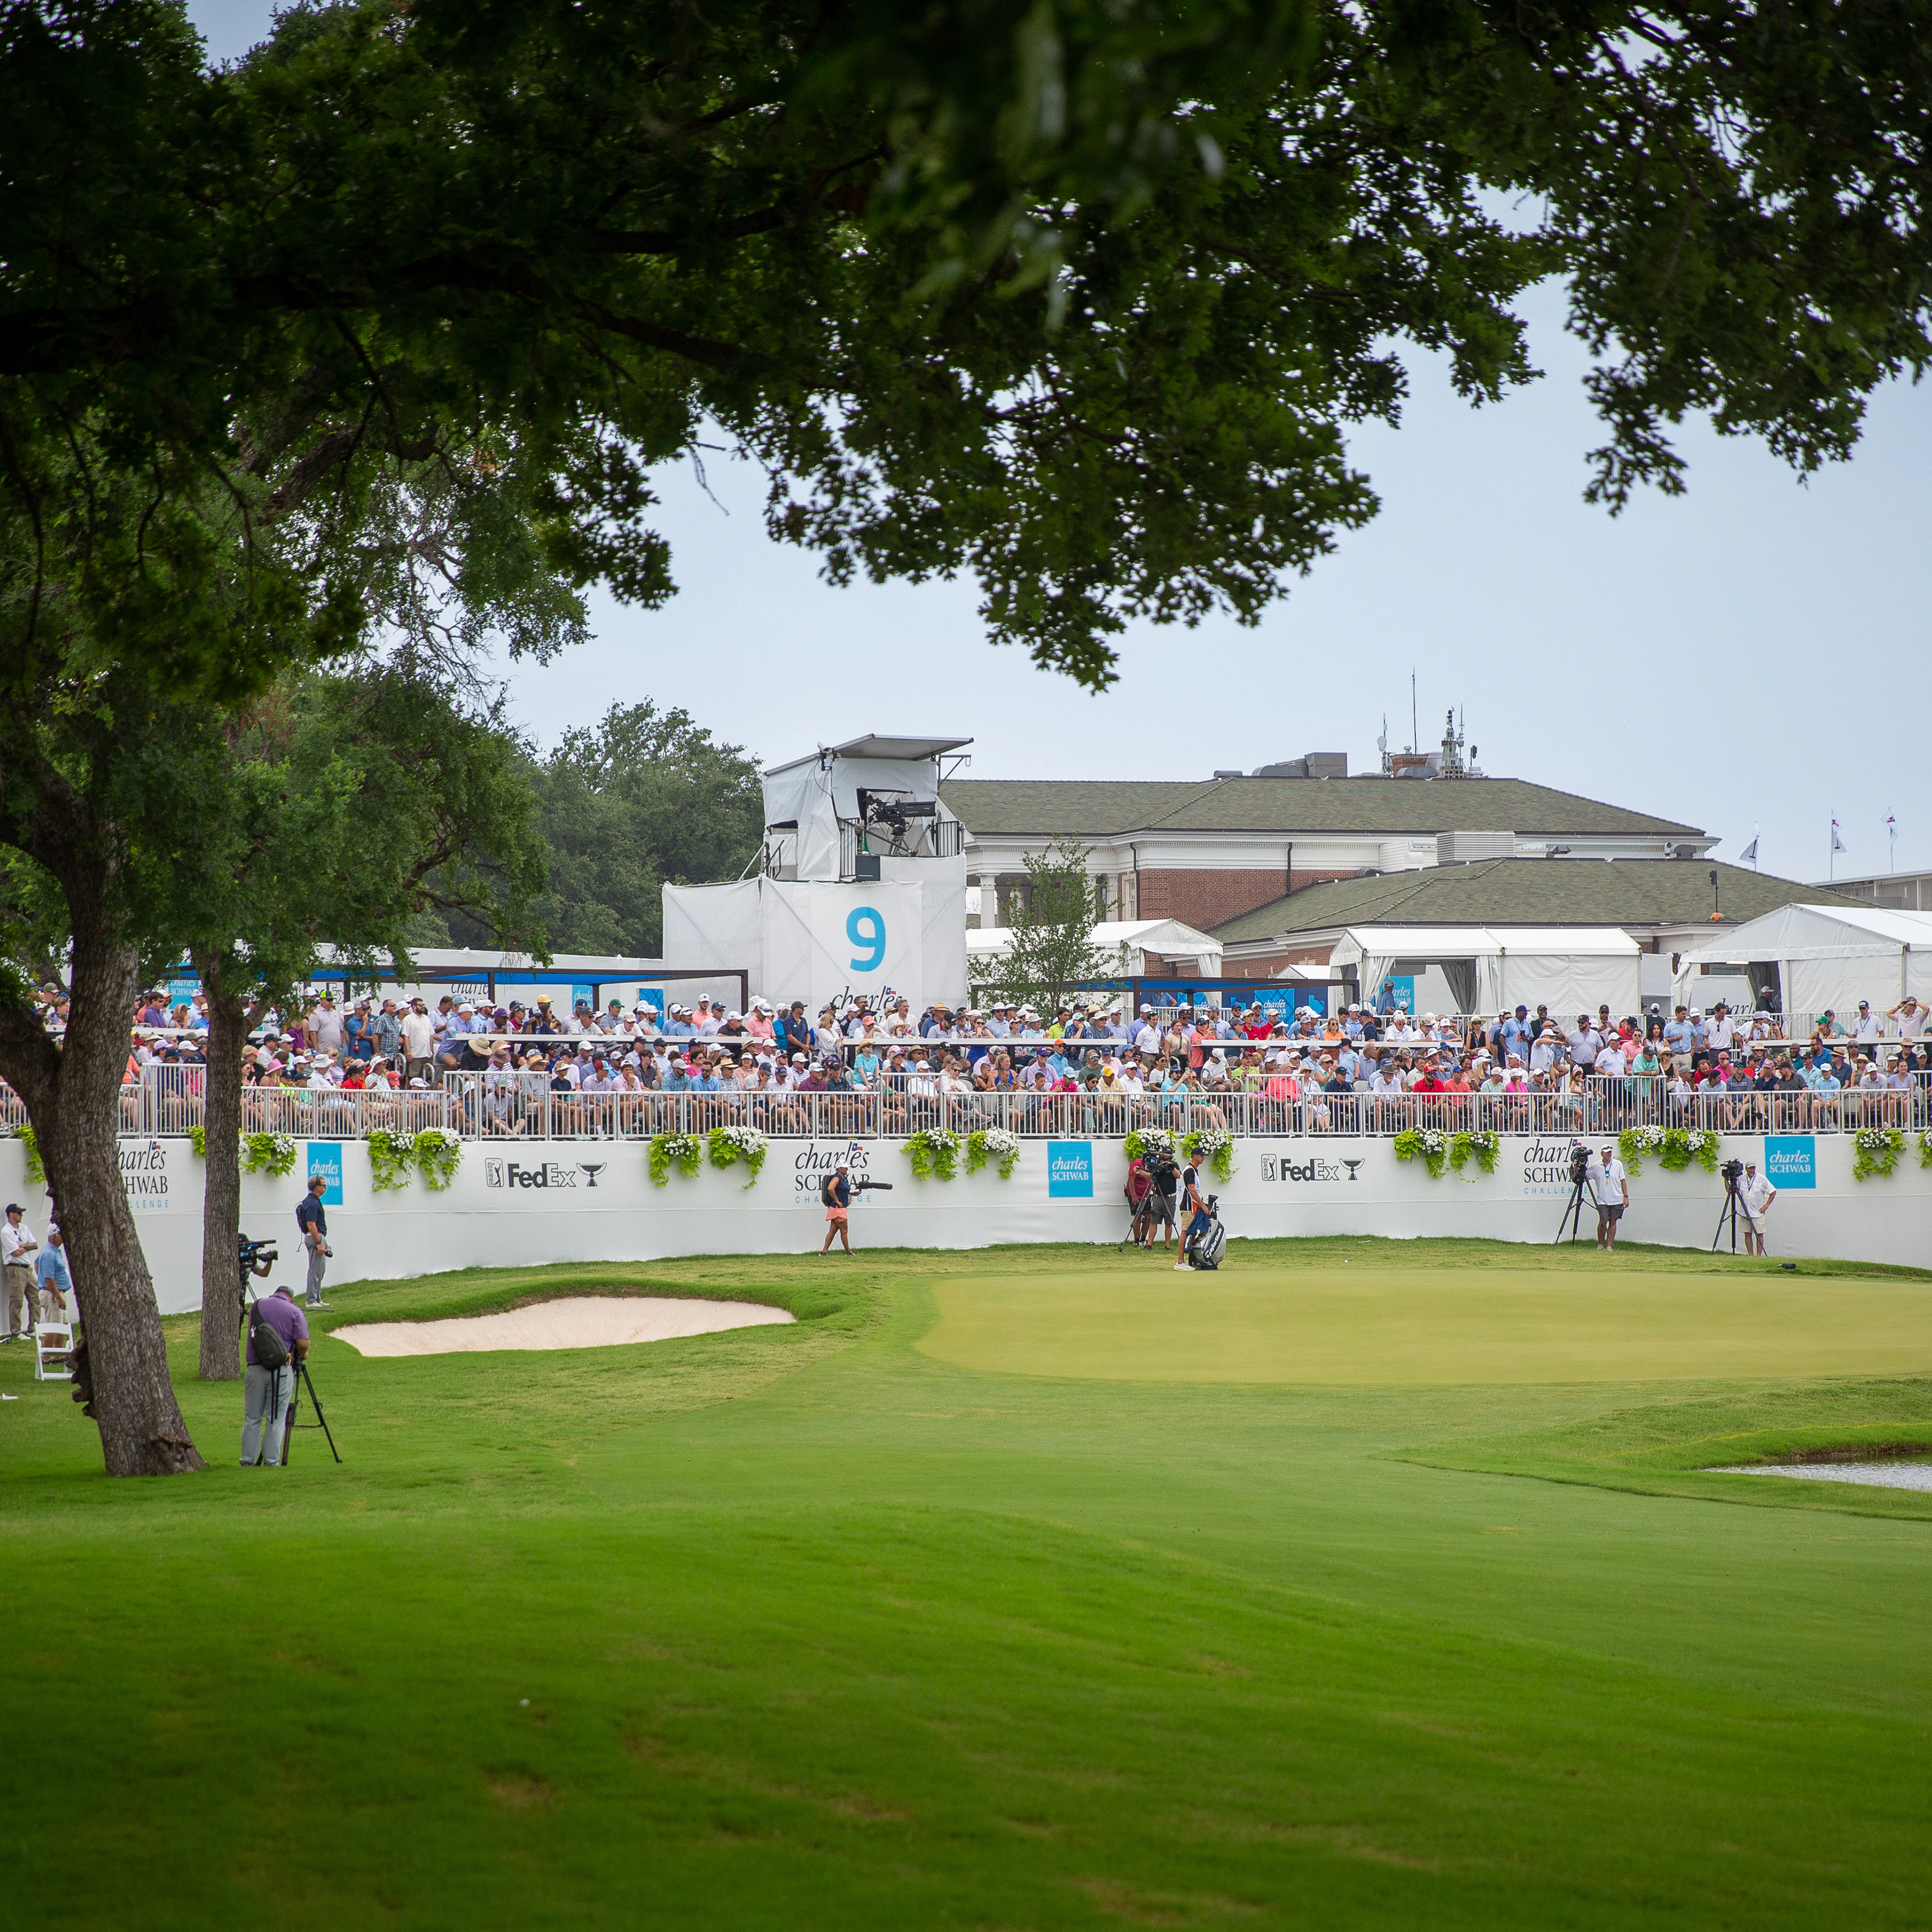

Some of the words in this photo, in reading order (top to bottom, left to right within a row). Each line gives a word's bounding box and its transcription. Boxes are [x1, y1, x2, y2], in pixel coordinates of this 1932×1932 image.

[845, 906, 887, 972] 9
[451, 984, 489, 995] charle
[574, 989, 593, 1000] charle
[1392, 986, 1411, 996] arles
[829, 985, 903, 1010] chrle
[1264, 999, 1286, 1008] charles
[117, 1139, 166, 1170] harles
[795, 1141, 869, 1170] charles
[1523, 1138, 1574, 1163] charl
[1770, 1149, 1811, 1164] charles
[311, 1159, 339, 1175] charles
[1052, 1156, 1088, 1170] charles
[1280, 1159, 1339, 1181] FedEx
[1770, 1164, 1811, 1173] SCHWAB
[325, 1176, 340, 1186] WAB
[507, 1163, 577, 1188] FedEx
[1052, 1171, 1089, 1181] SCHWAB
[1523, 1167, 1572, 1183] SCHW
[124, 1176, 168, 1194] HWAB
[130, 1199, 169, 1208] LLENGE
